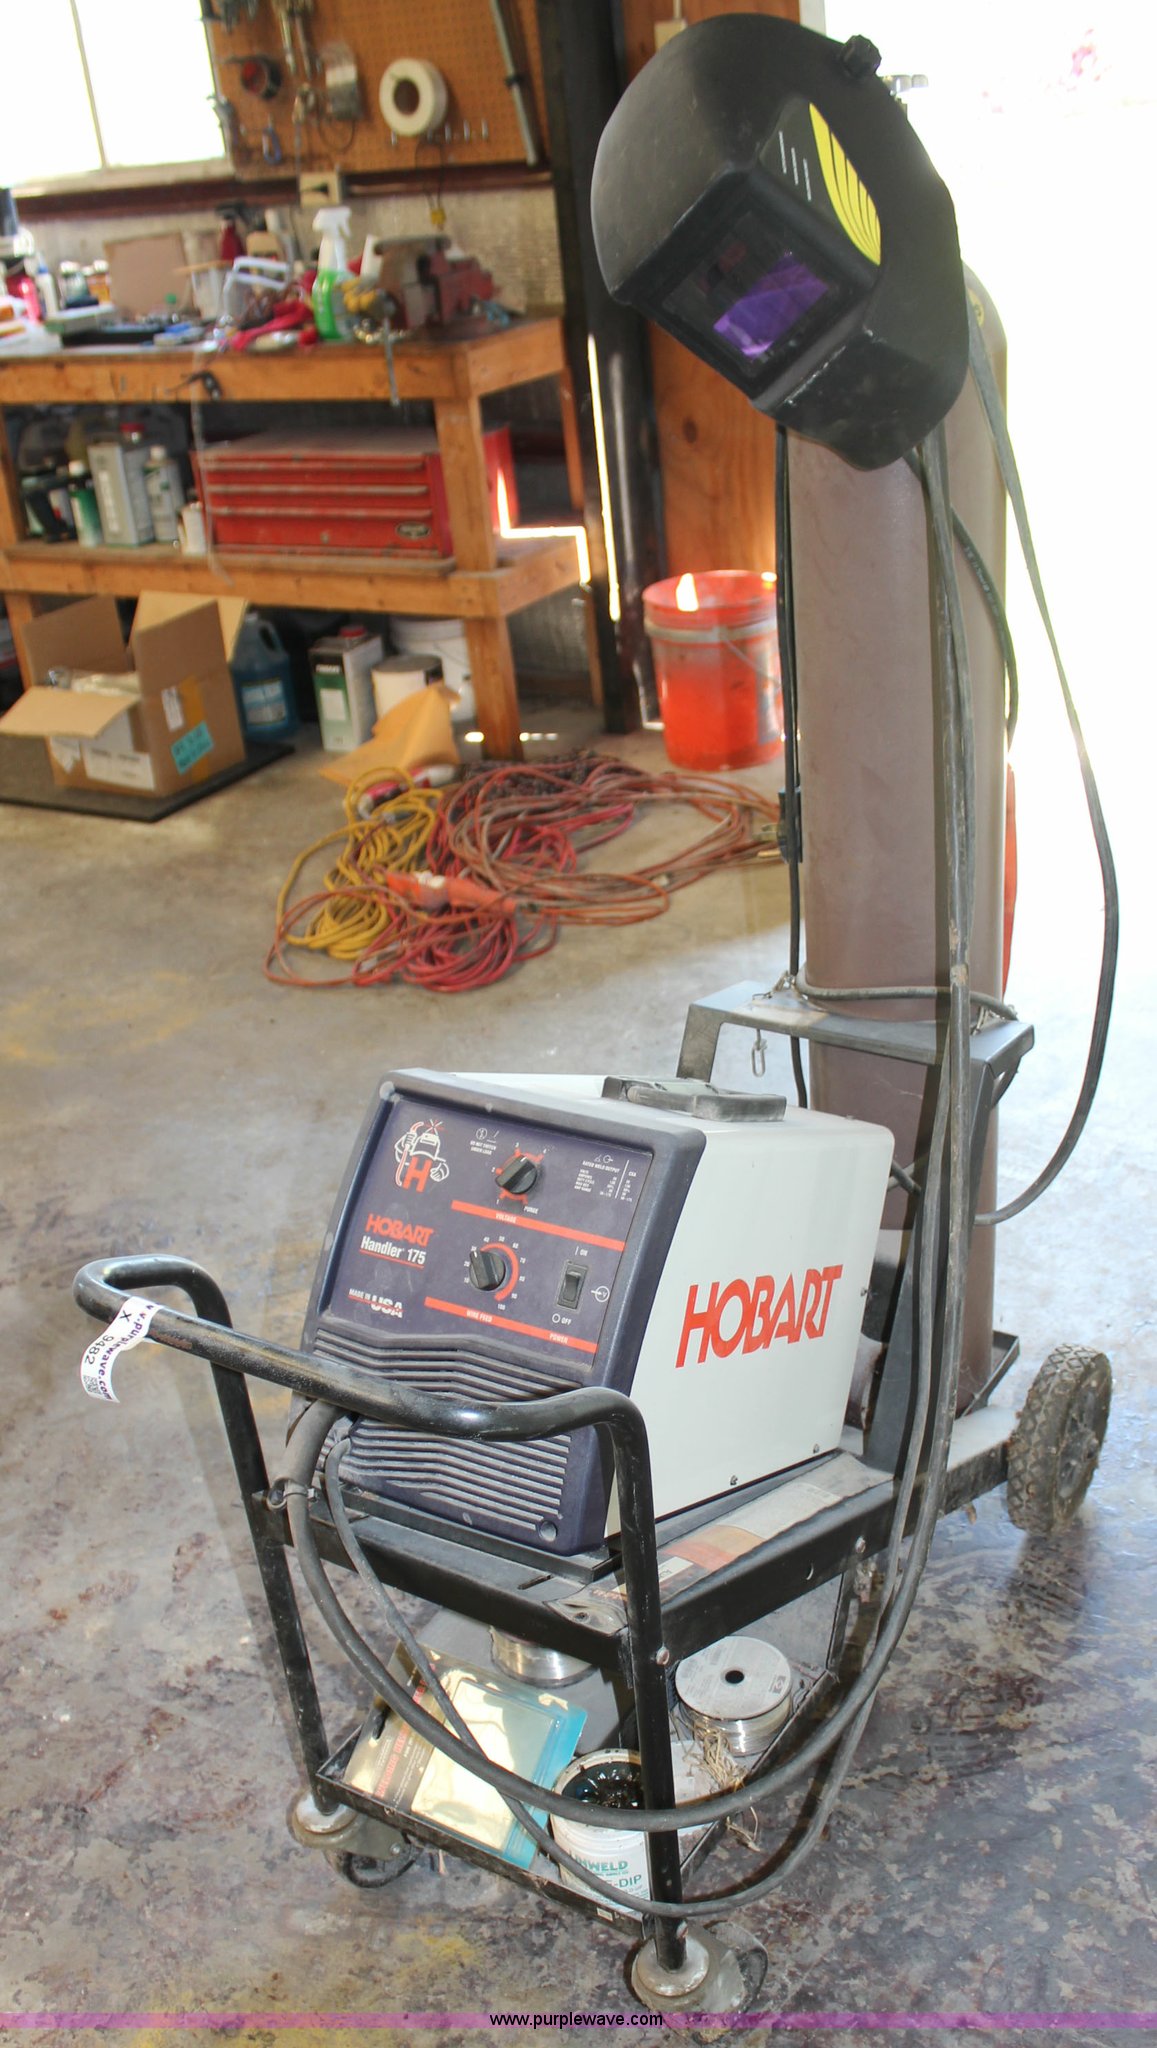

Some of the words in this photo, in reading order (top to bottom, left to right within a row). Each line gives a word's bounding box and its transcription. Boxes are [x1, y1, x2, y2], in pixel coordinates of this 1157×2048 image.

[364, 1213, 434, 1247] HOBART
[495, 1212, 518, 1224] VOLTAGE
[360, 1235, 403, 1259] Handler
[407, 1248, 427, 1265] 175
[370, 1295, 404, 1319] USA
[466, 1309, 480, 1319] WIRE
[480, 1313, 493, 1324] FEED
[675, 1264, 843, 1368] HOBART
[561, 1317, 572, 1326] OFF
[84, 1334, 115, 1365] 9482
[549, 1332, 569, 1344] POWER
